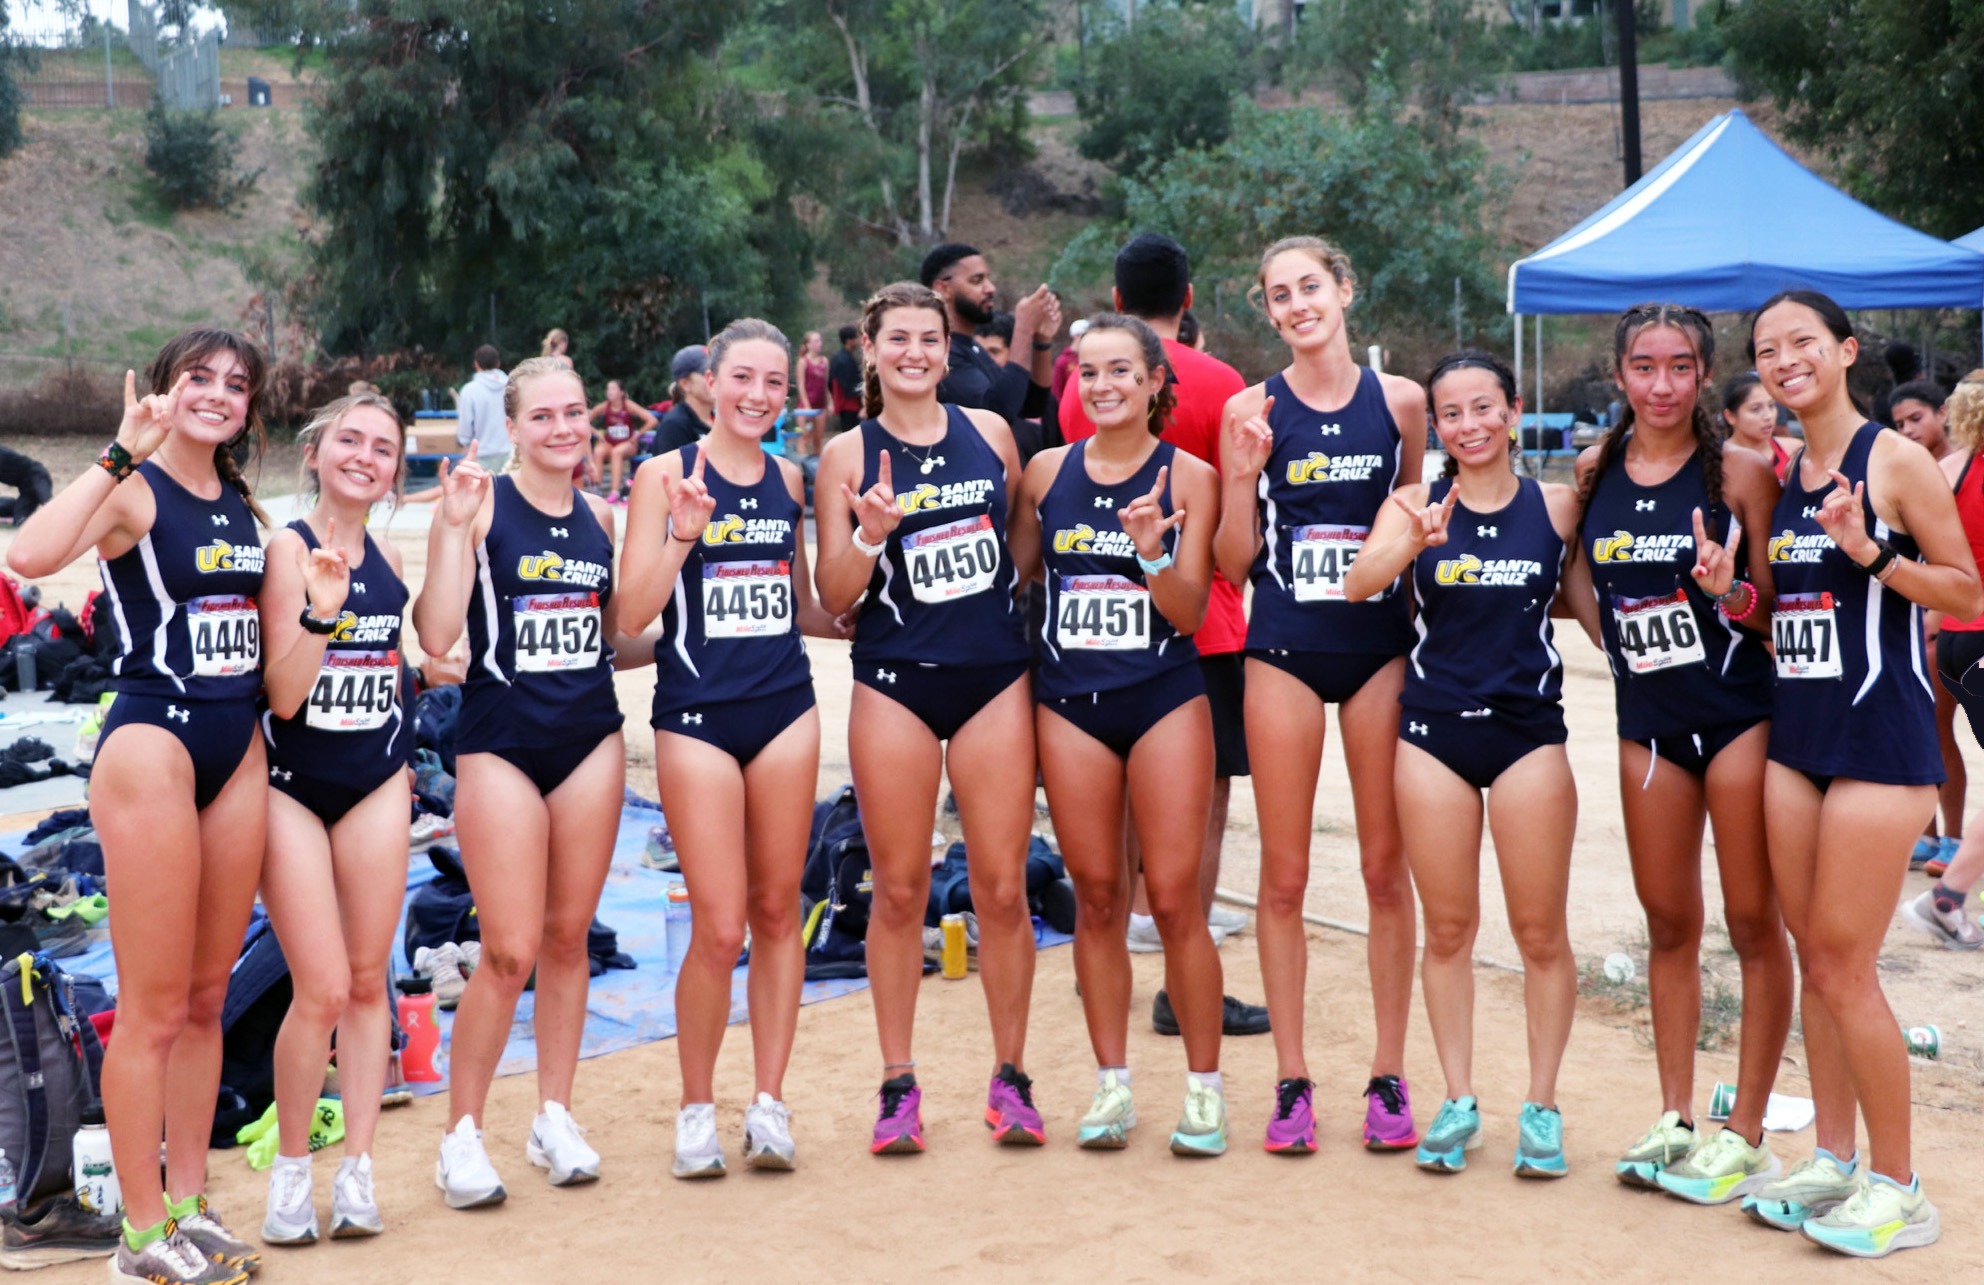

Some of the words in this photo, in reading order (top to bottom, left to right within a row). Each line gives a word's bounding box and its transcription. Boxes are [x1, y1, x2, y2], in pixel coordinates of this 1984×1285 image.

[1330, 455, 1382, 468] SANTA
[1328, 467, 1372, 480] CRUZ
[940, 479, 994, 497] SANTA
[940, 491, 987, 508] CRUZ
[746, 519, 791, 532] SANTA
[744, 530, 784, 543] CRUZ
[1634, 535, 1693, 549] SANTA
[1792, 534, 1836, 549] SANTA
[234, 545, 265, 560] SANT
[1091, 542, 1136, 557] CRUZ
[1632, 547, 1677, 561] CRUZ
[1791, 548, 1823, 563] CRUZ
[234, 559, 264, 573] CRUZ
[564, 559, 608, 579] SANTA
[913, 538, 996, 588] 4450
[1482, 559, 1541, 575] SANTA
[562, 571, 601, 587] CRUZ
[1480, 572, 1528, 586] CRUZ
[706, 582, 788, 621] 4453
[358, 615, 400, 629] SANTA
[1060, 598, 1144, 637] 4451
[196, 618, 258, 661] 4449
[517, 614, 599, 656] 4452
[1776, 618, 1831, 663] 4447
[310, 674, 394, 714] 4445
